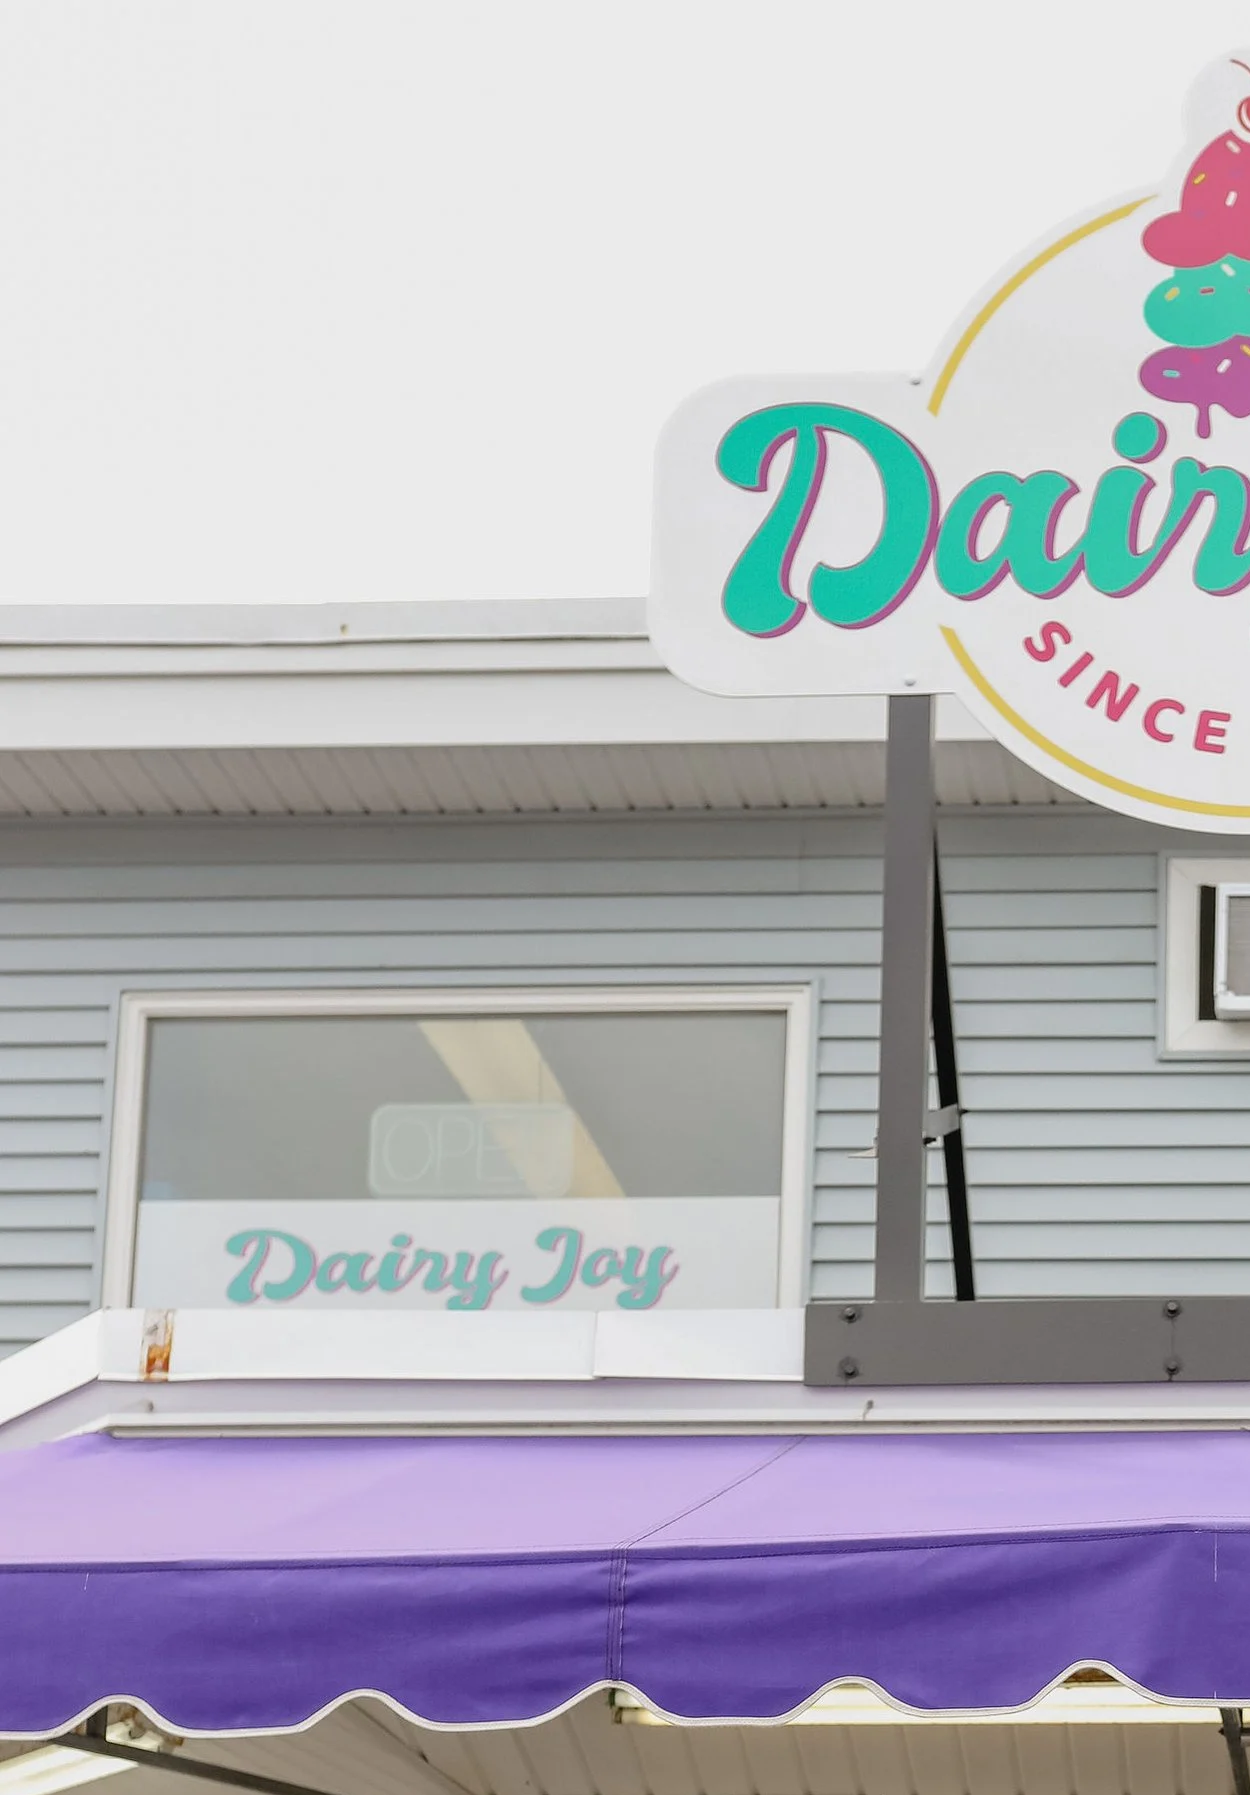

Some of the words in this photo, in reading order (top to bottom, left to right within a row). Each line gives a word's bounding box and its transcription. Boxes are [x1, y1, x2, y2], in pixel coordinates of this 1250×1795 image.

[1022, 619, 1232, 754] SINCE
[382, 1116, 545, 1183] OPE
[225, 1228, 509, 1310] Dairy
[520, 1226, 680, 1309] Joy
